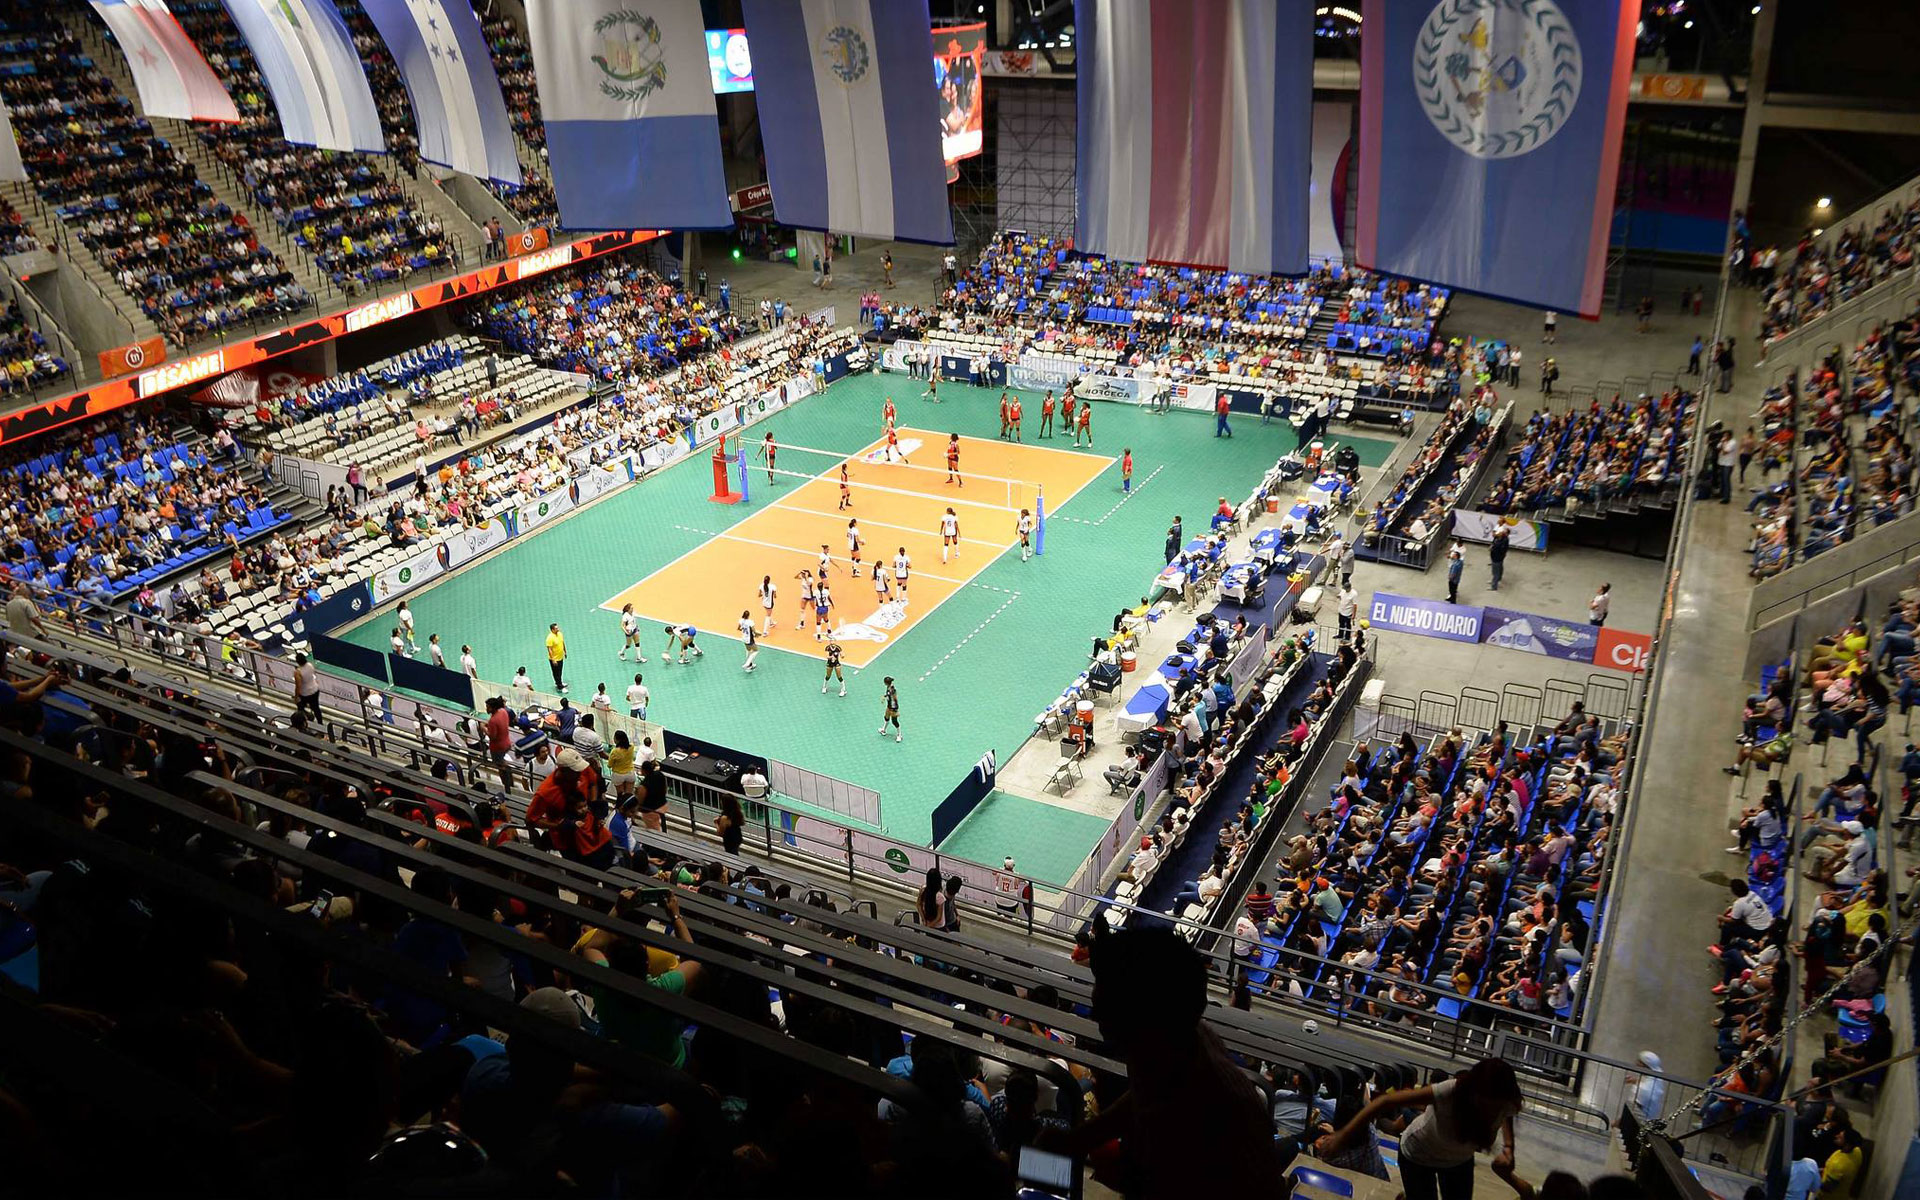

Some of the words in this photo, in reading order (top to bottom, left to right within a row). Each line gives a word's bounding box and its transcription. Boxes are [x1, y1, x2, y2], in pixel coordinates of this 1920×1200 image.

[1013, 367, 1064, 384] molten
[898, 561, 904, 569] 9
[1371, 602, 1388, 623] EL
[1389, 604, 1432, 630] NUEVO
[1433, 612, 1478, 637] DIARIO
